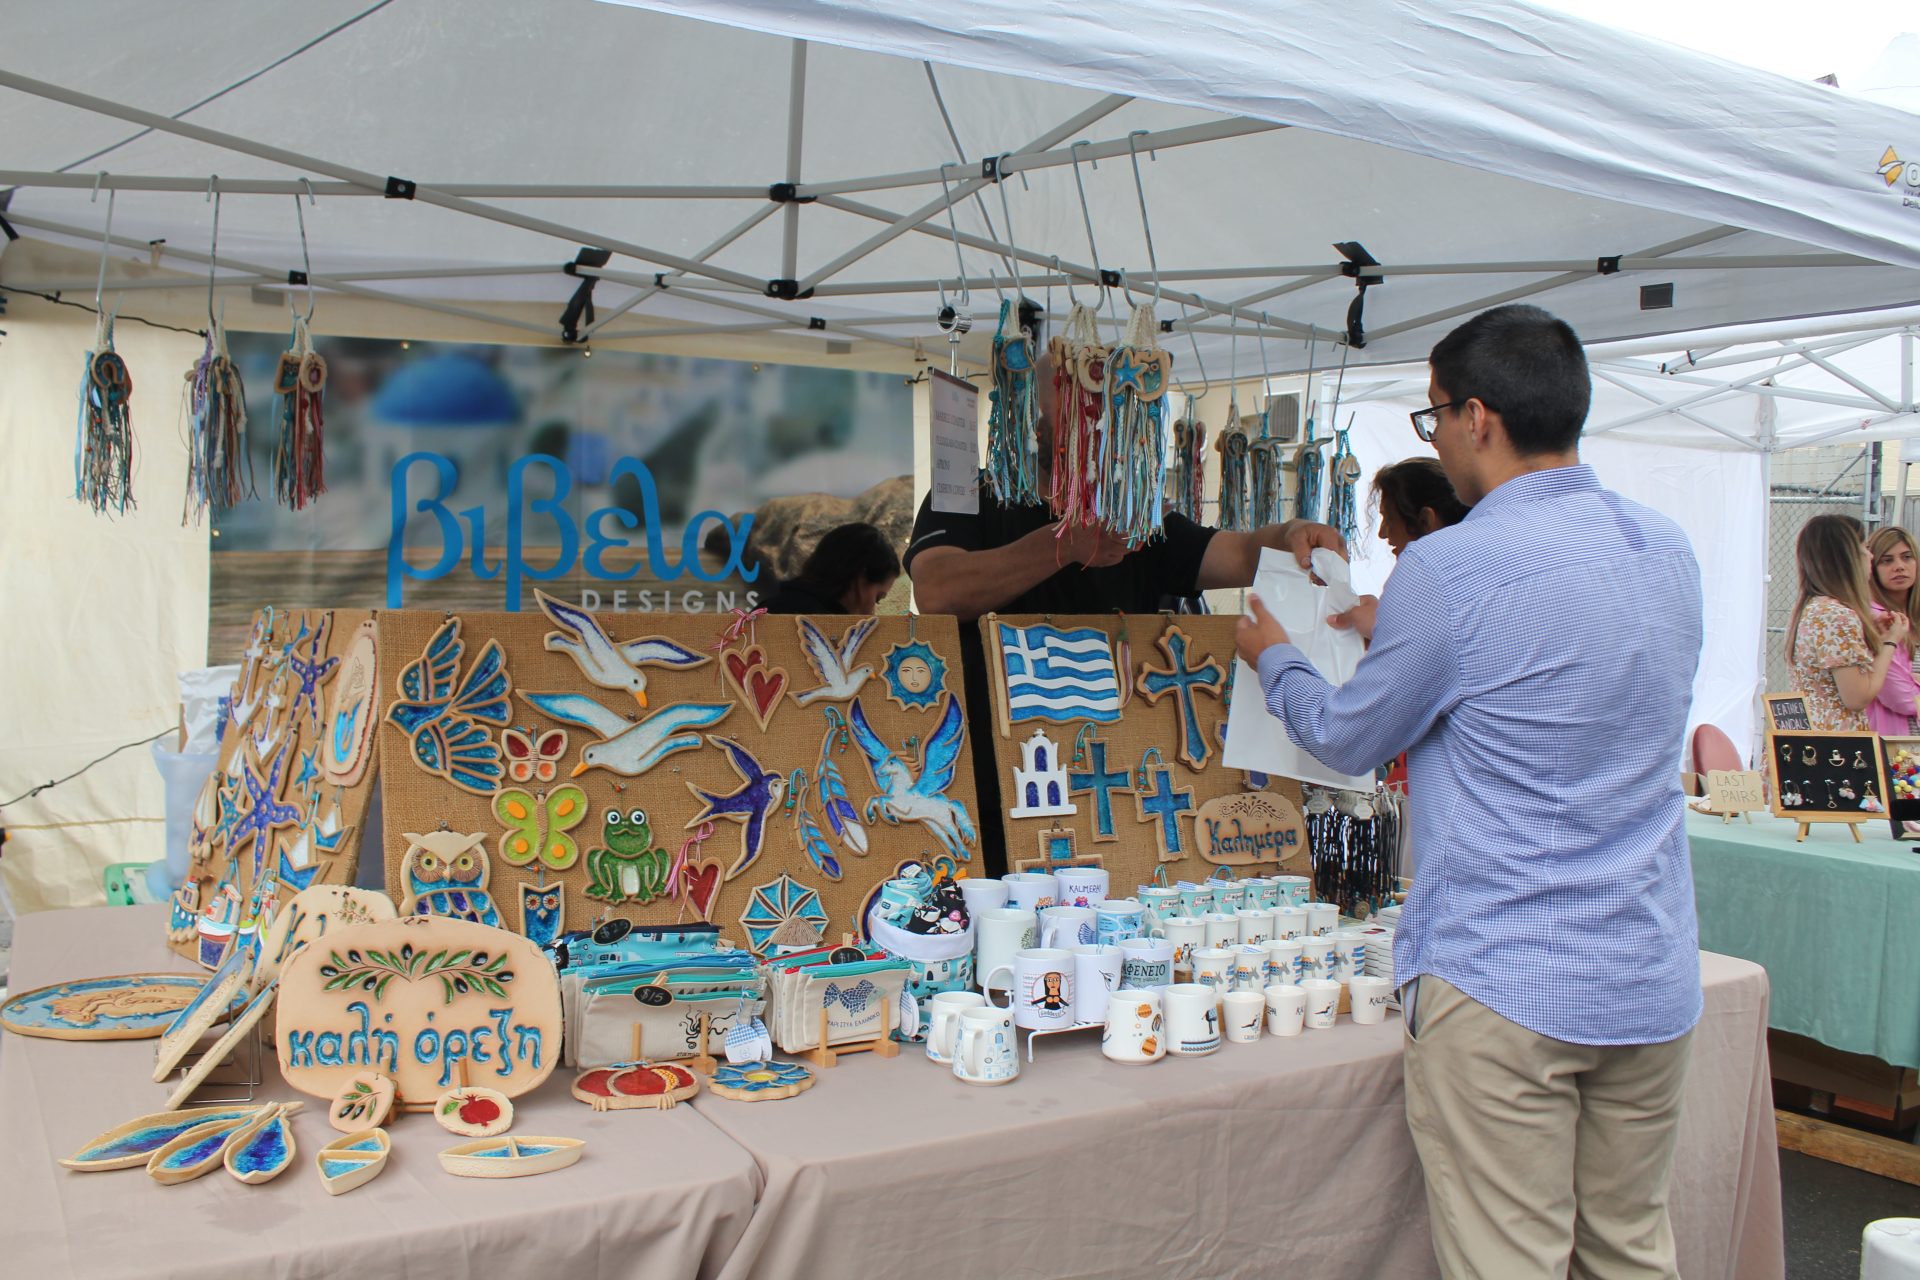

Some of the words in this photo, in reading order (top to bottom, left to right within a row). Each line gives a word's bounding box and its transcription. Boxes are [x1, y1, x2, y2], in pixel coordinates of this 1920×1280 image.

[581, 589, 760, 613] DESIGNS
[1771, 702, 1805, 717] LEATHER
[1775, 718, 1811, 731] SANDALS
[1715, 775, 1747, 786] LAST
[1721, 789, 1758, 802] PAIRS
[640, 988, 664, 1003] $15
[288, 1001, 400, 1073] καλή
[414, 1007, 543, 1087] όρεξη
